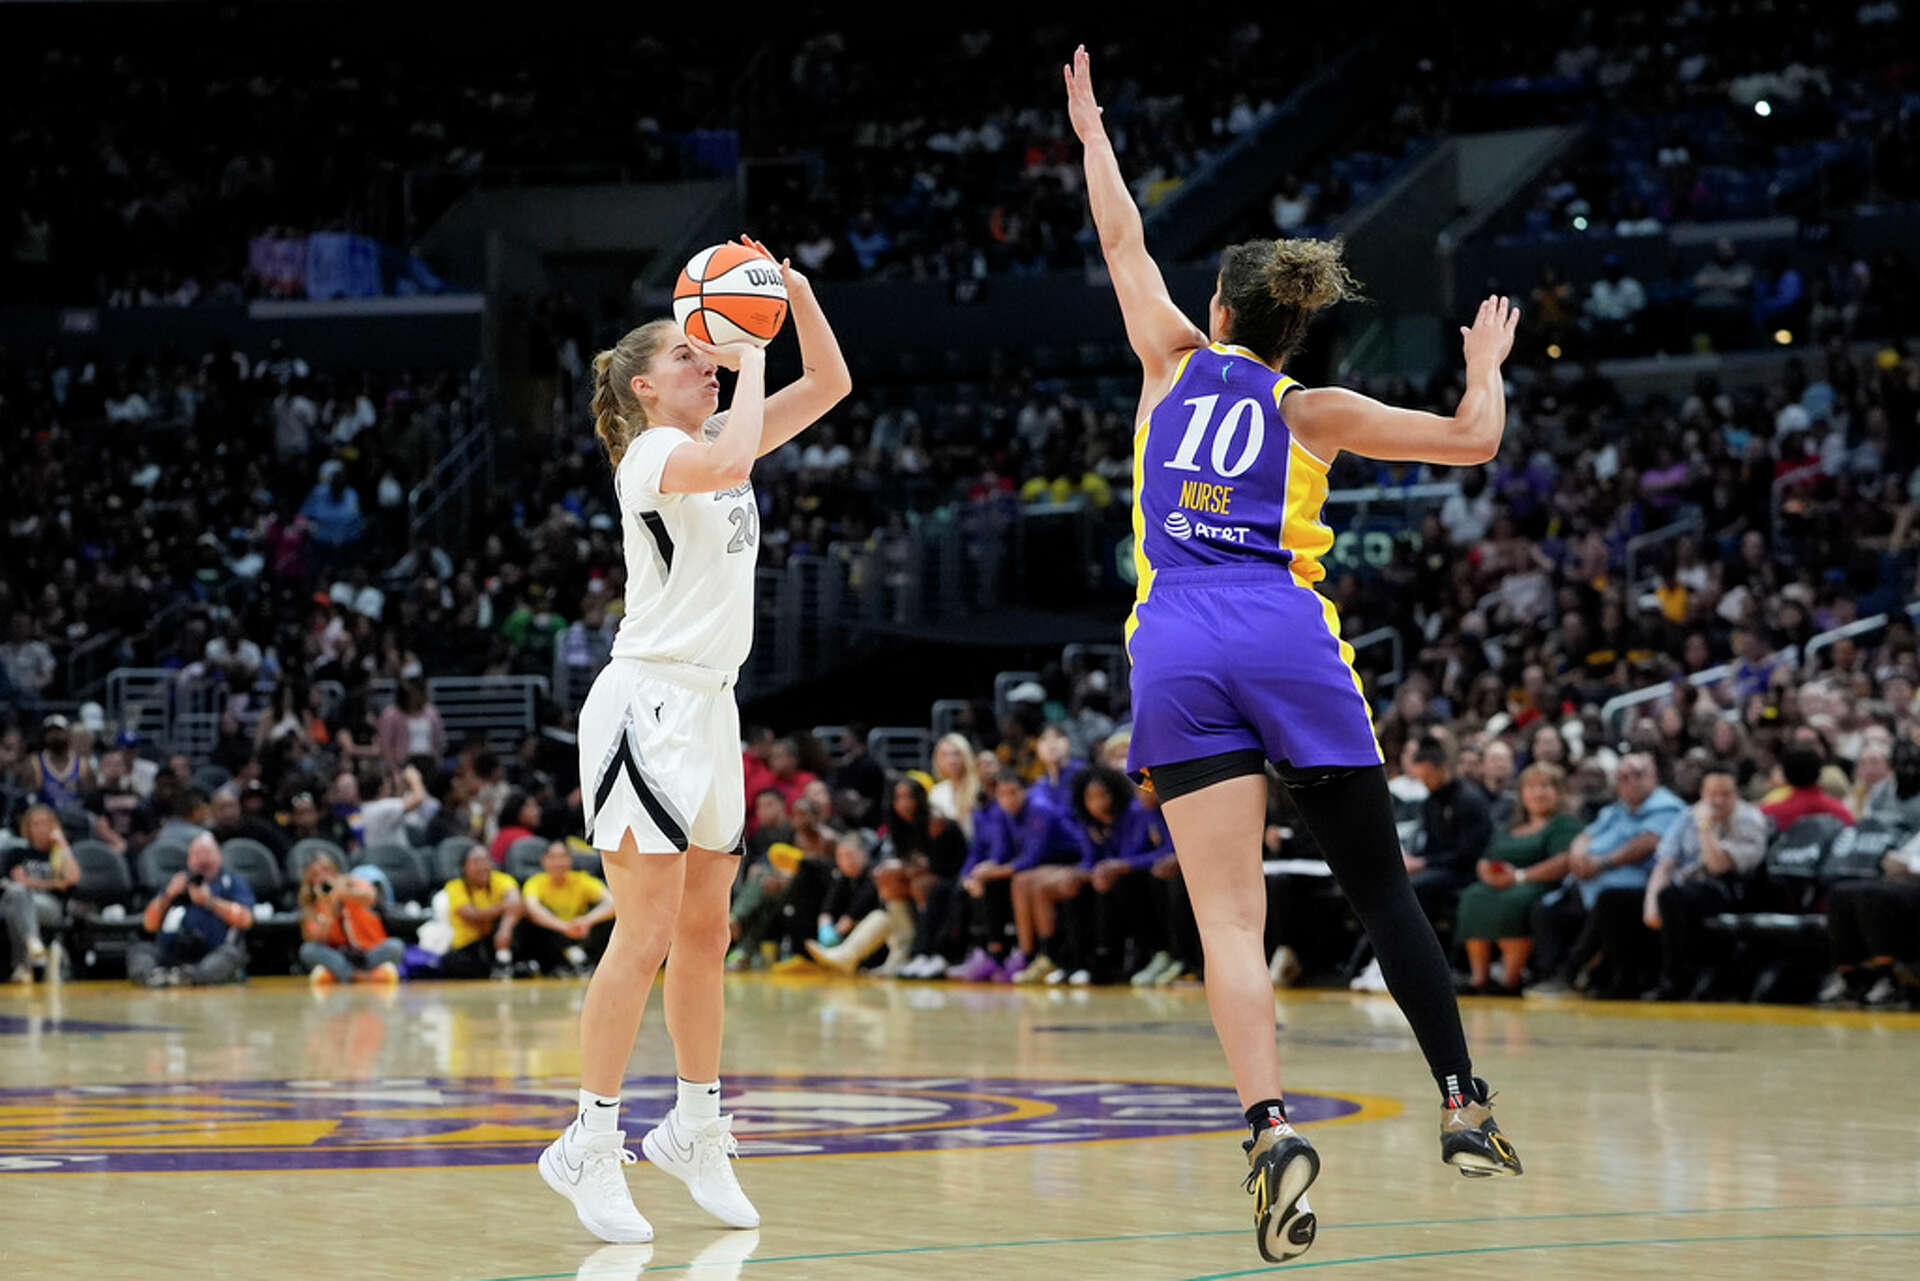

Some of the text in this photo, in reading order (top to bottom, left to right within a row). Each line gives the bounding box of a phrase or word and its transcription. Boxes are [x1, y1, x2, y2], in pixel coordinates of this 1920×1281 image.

[1163, 393, 1265, 478] 10
[1178, 479, 1234, 515] NURSE
[727, 502, 758, 553] 20
[1195, 524, 1251, 543] AT&T
